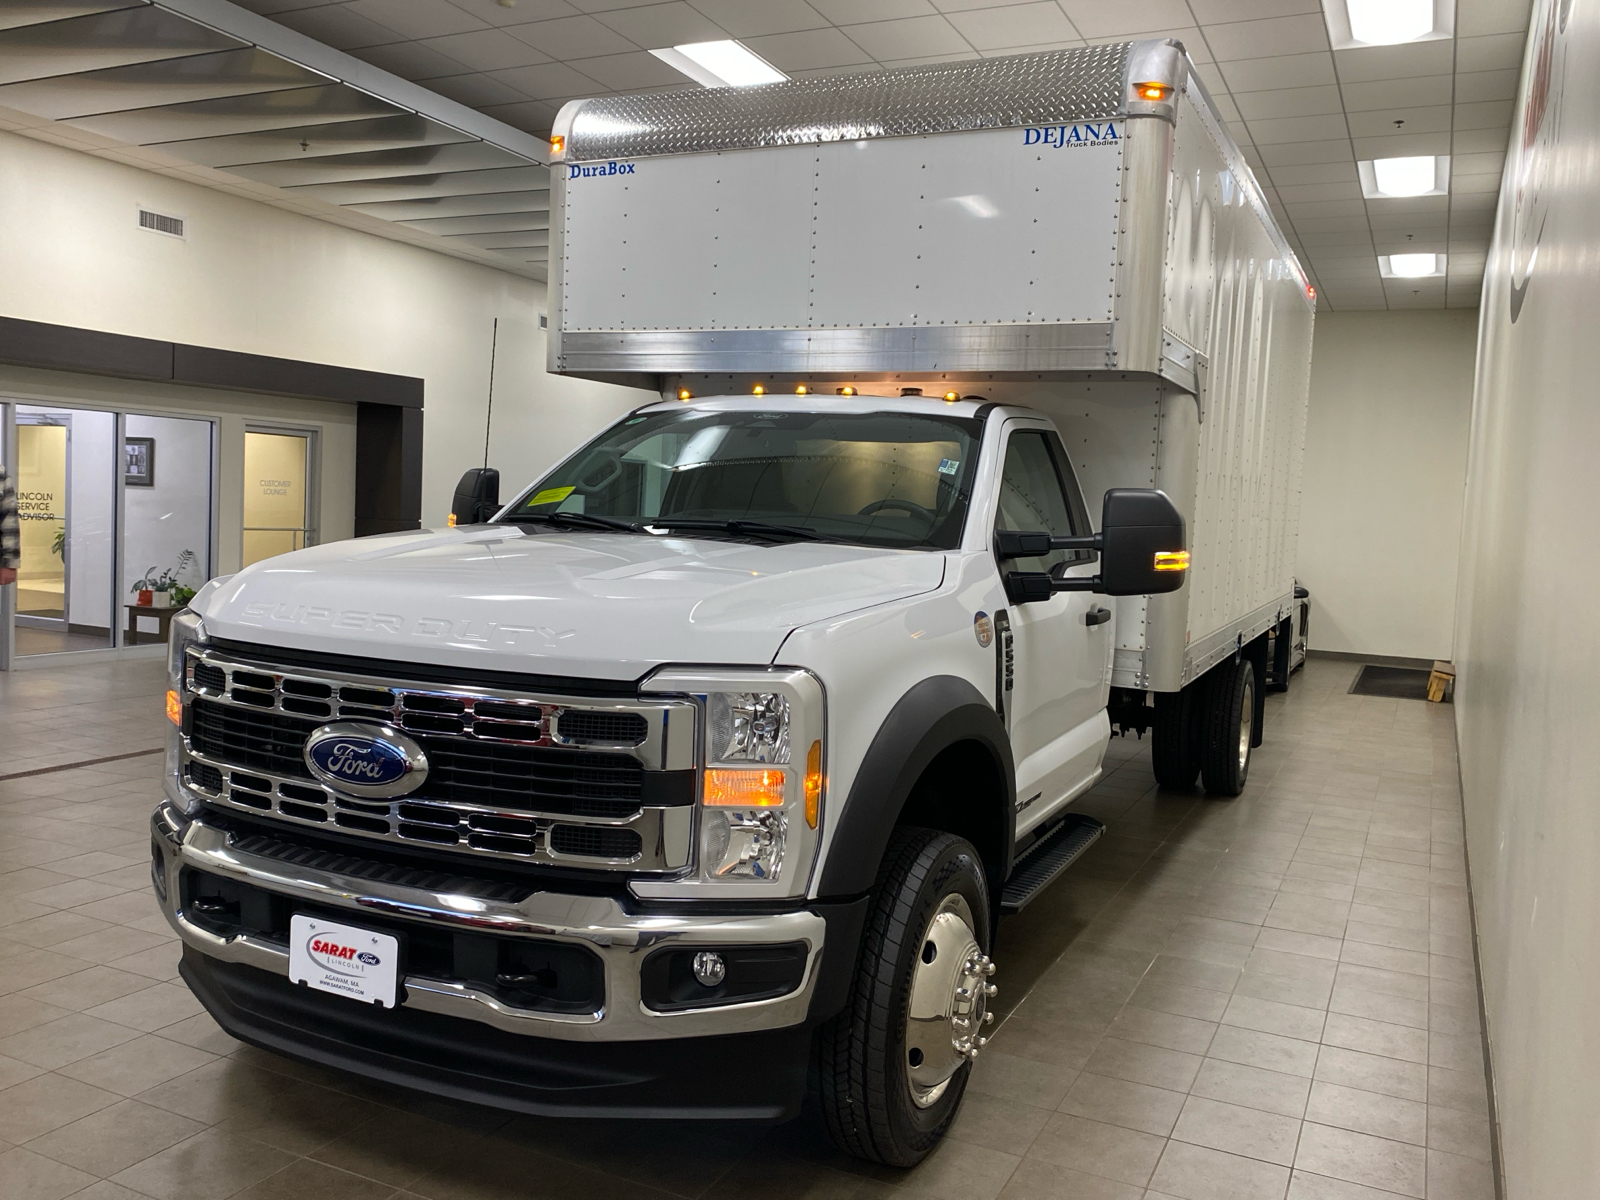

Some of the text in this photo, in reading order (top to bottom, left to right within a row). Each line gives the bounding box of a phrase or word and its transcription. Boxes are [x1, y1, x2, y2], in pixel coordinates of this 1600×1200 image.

[1023, 122, 1118, 149] DEJANA
[569, 161, 635, 179] DuraBox
[259, 479, 292, 488] CUSTOMER
[15, 492, 53, 501] LINCOLN
[263, 488, 288, 496] LOUNGE
[17, 502, 50, 511] SERVICE
[243, 600, 576, 648] SUPER DUTY
[327, 742, 385, 779] Ford
[311, 939, 377, 965] SARAT Ford
[331, 958, 360, 970] LINCOLN
[320, 980, 364, 995] WWW.SARATFORD.COM
[324, 974, 360, 988] AGAWAM, MA
